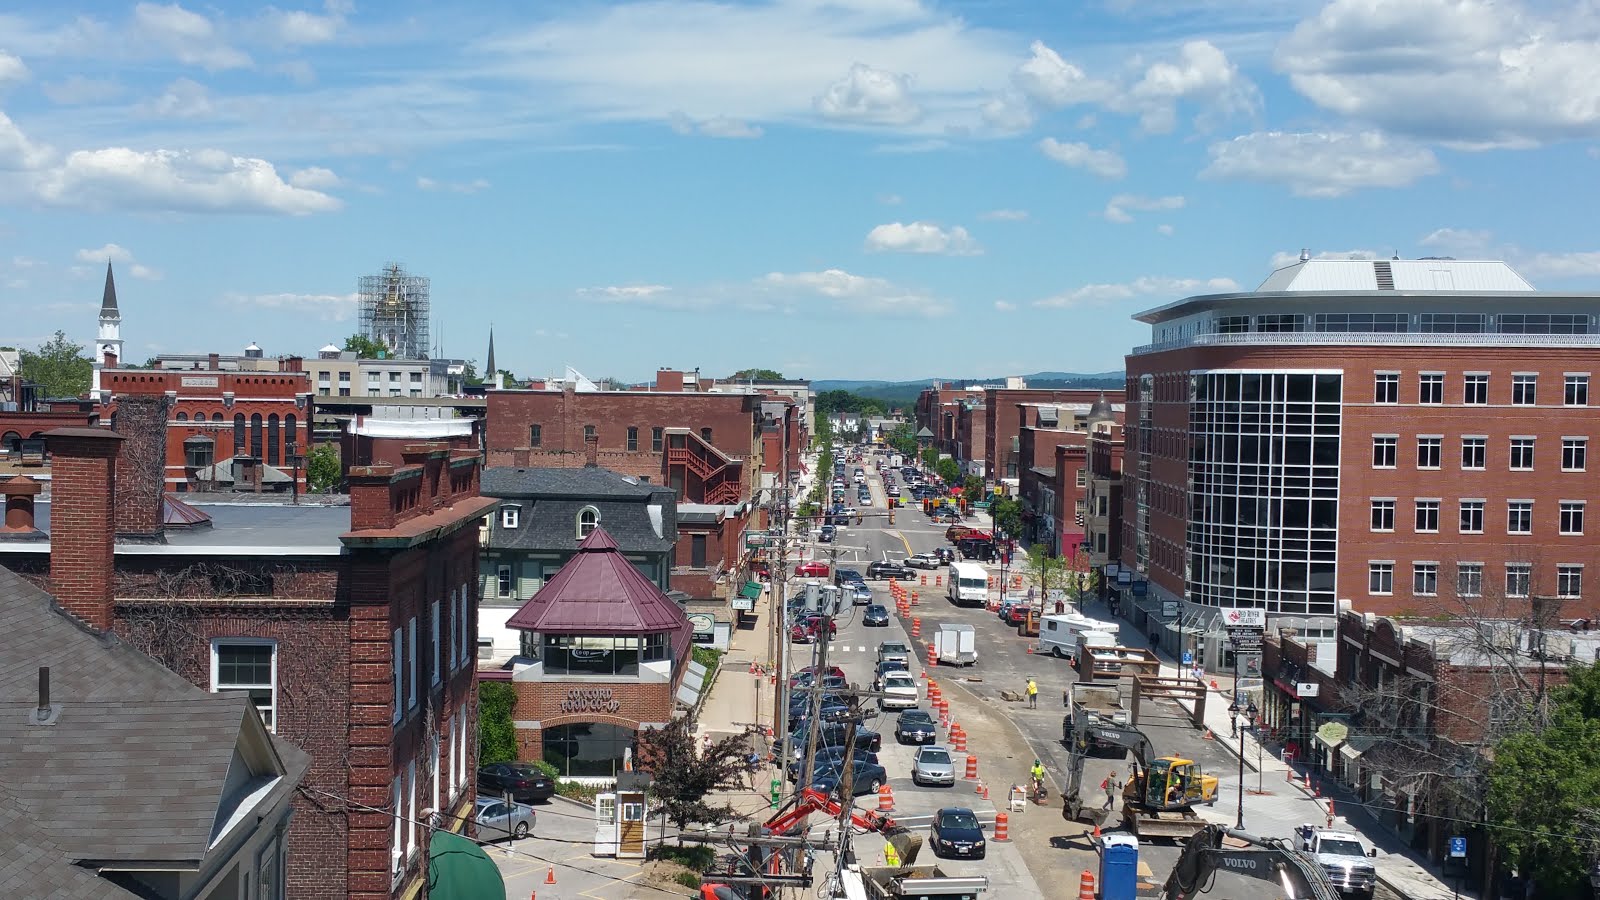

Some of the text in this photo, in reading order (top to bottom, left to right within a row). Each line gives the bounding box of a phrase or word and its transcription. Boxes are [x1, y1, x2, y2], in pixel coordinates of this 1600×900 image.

[1248, 610, 1260, 618] RIVER
[567, 688, 613, 699] CONCORD
[561, 699, 620, 712] FOOD CO-OP
[1101, 730, 1121, 739] VOLVO
[1222, 857, 1257, 870] VOLVO
